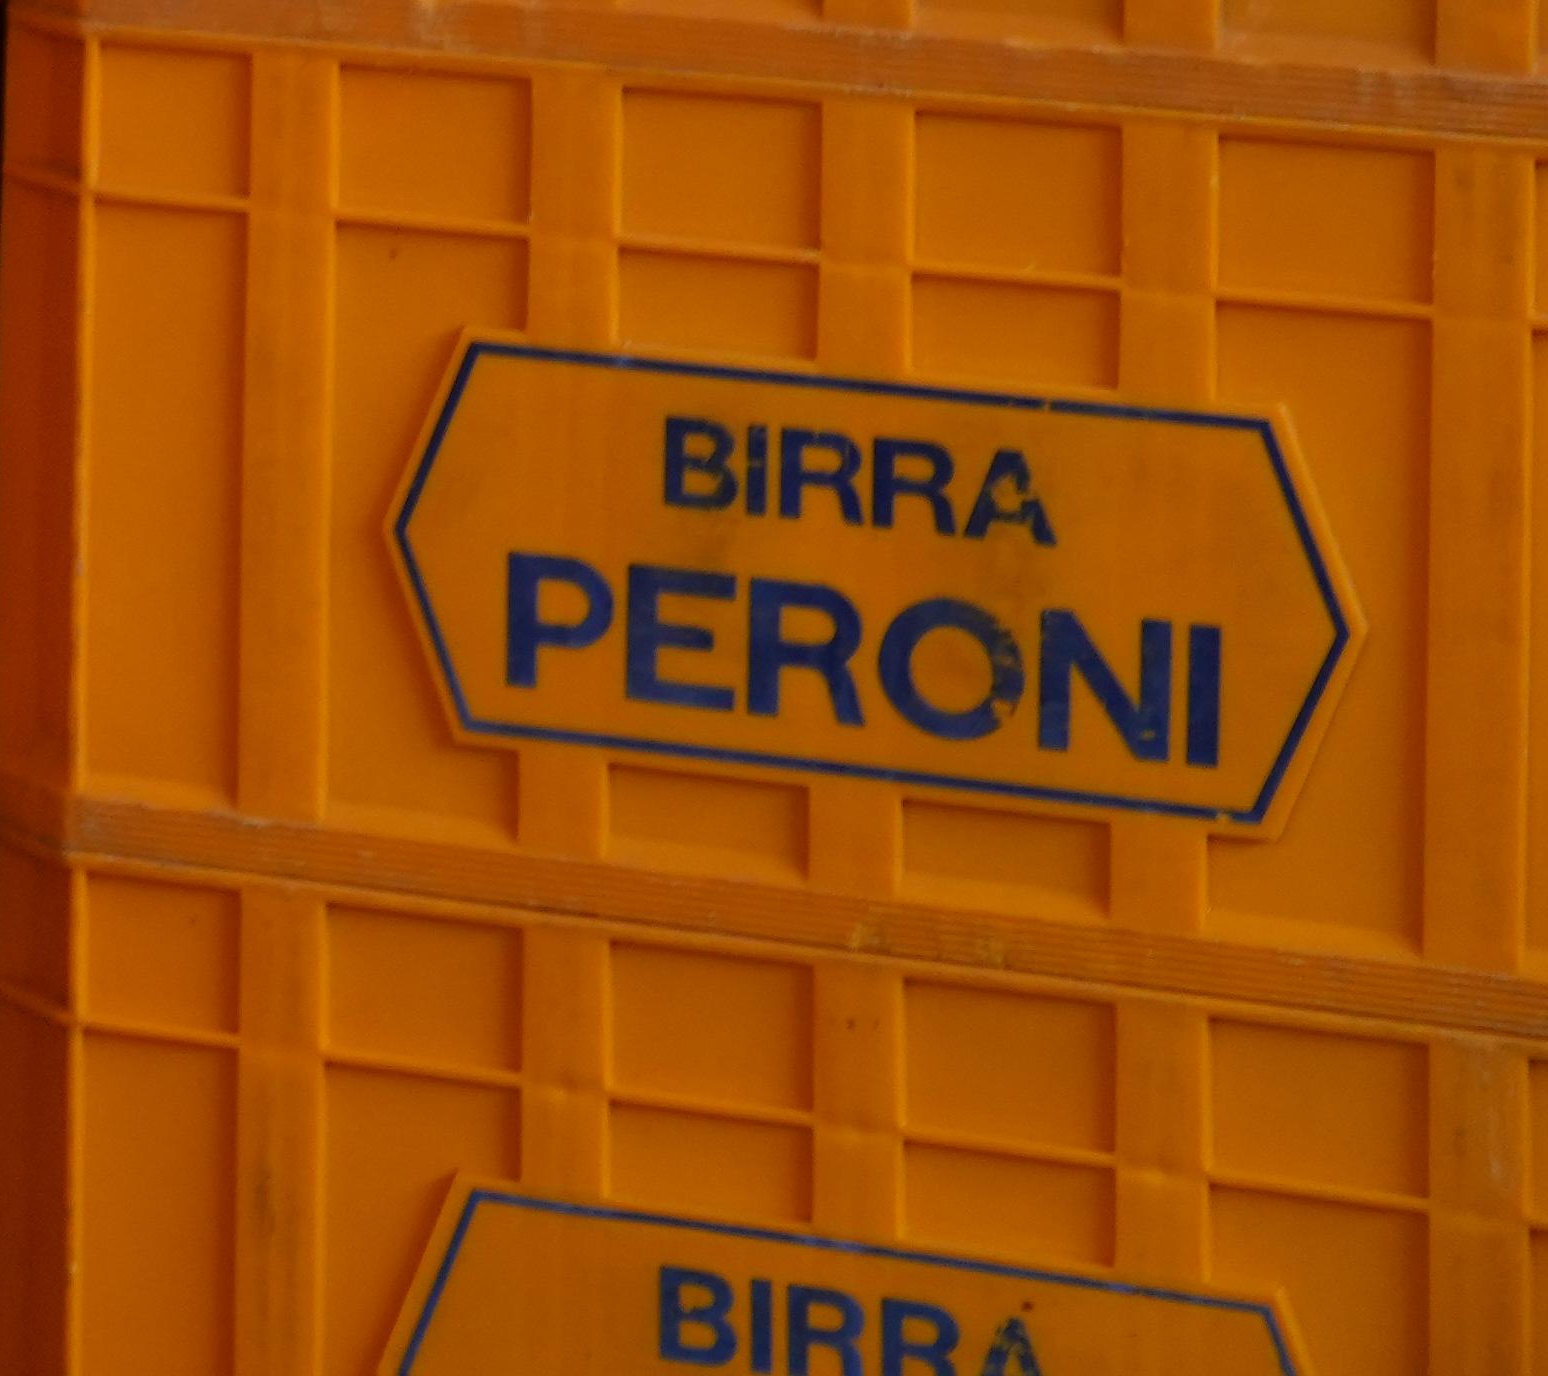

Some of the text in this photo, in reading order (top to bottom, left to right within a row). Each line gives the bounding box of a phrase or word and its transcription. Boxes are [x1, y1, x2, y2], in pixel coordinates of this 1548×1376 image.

[664, 416, 1057, 547] BIRRA
[507, 552, 1223, 767] PERONI
[659, 1265, 1043, 1376] BIRRA
